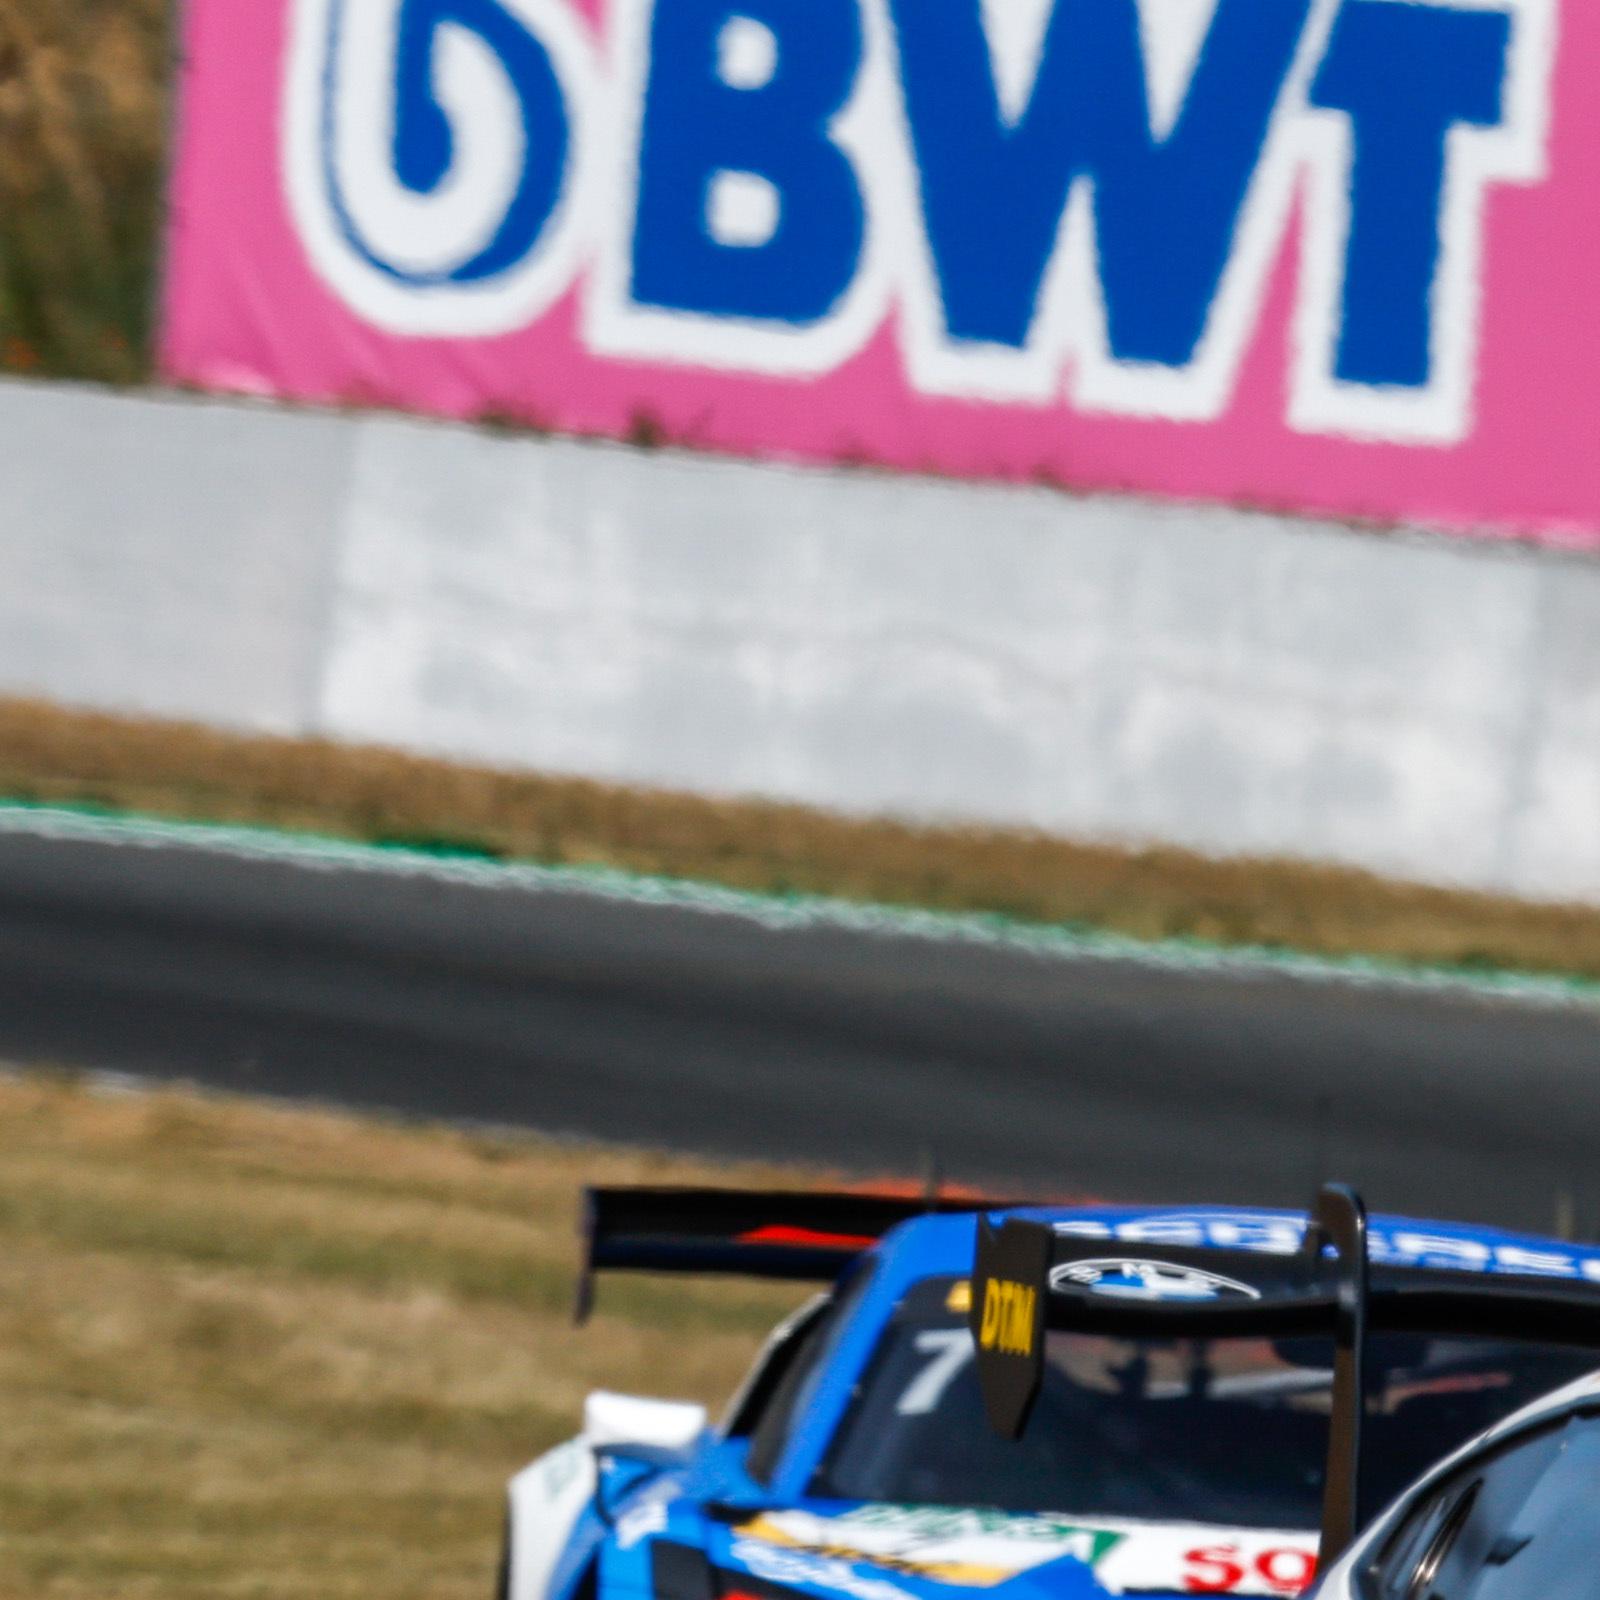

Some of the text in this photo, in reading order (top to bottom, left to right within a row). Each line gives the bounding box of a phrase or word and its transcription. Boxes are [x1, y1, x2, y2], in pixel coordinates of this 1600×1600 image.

[628, 0, 1514, 390] BWT
[979, 1276, 1037, 1357] DTM
[897, 1326, 977, 1416] 7
